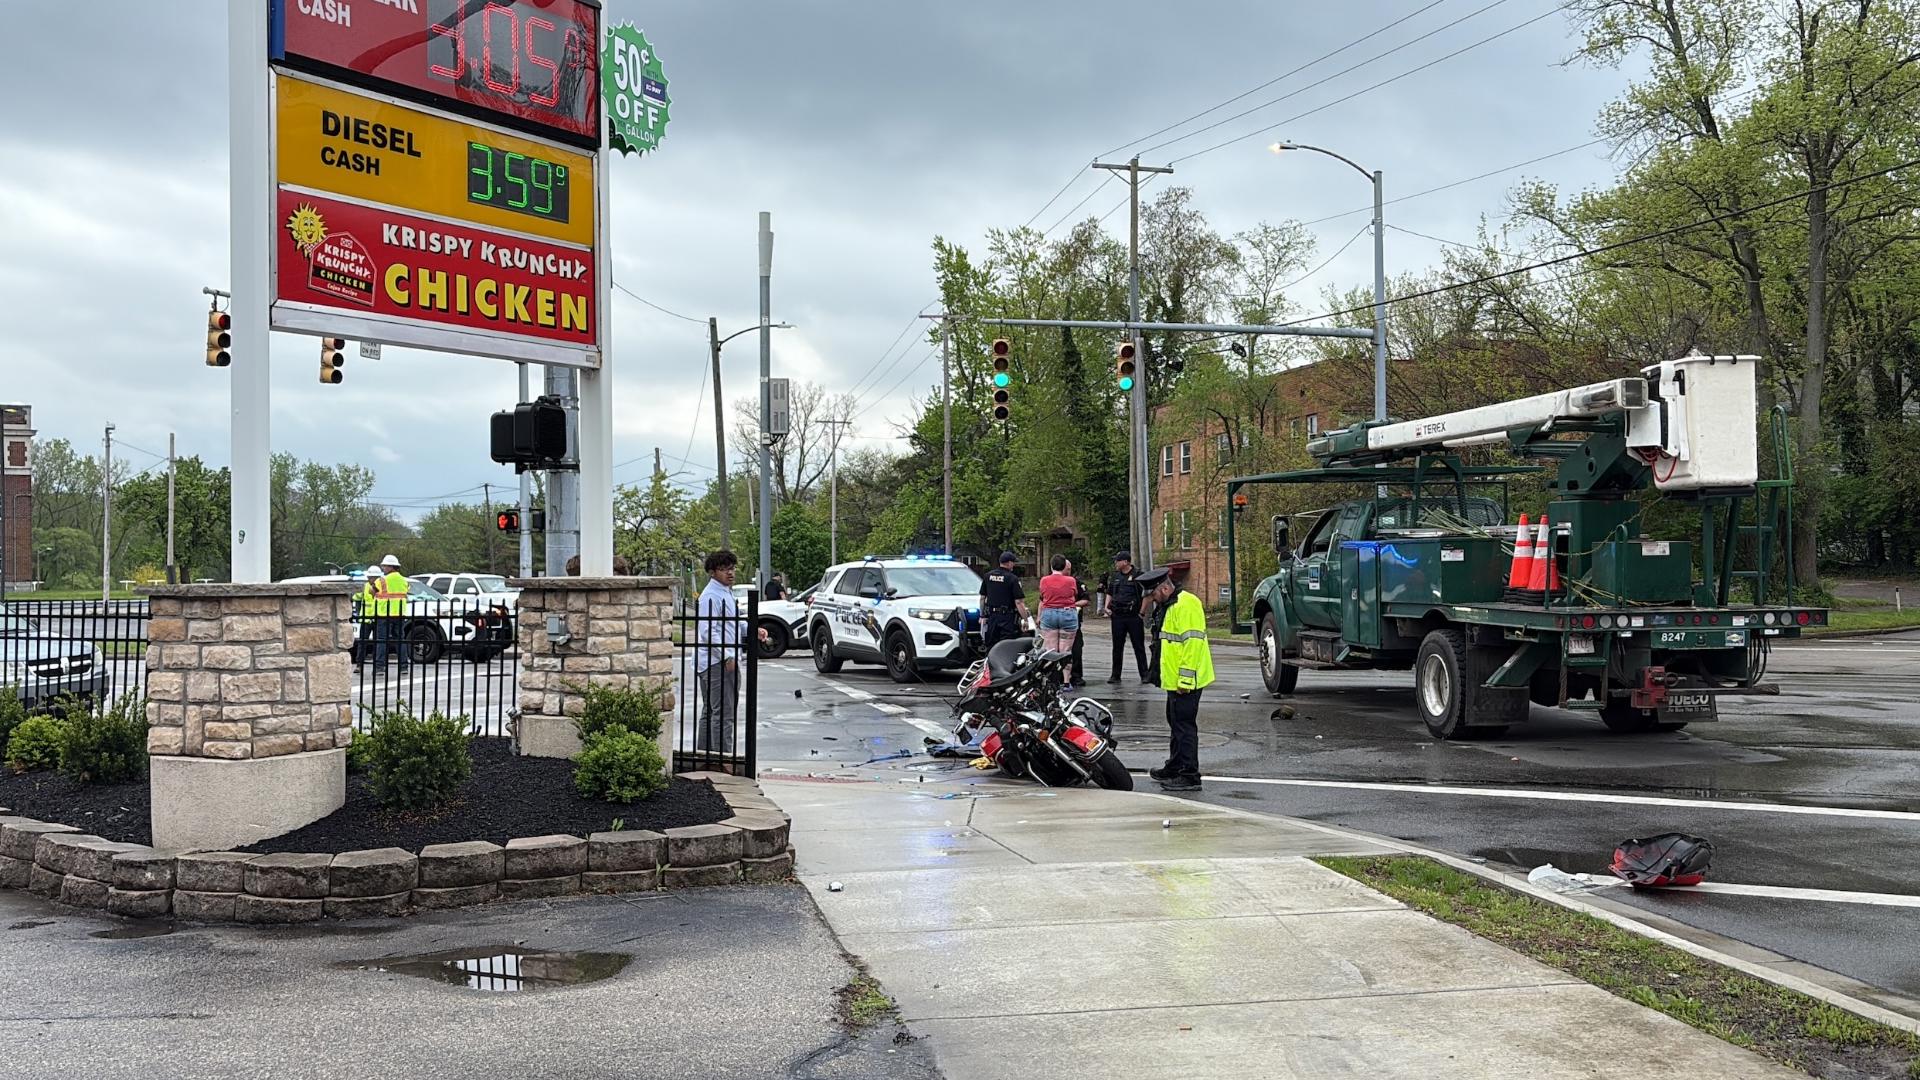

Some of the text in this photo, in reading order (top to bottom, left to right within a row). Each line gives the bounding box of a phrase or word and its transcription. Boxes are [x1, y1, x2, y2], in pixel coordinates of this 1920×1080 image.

[298, 0, 350, 27] CASH
[615, 93, 659, 130] OFF
[322, 110, 421, 158] DIESEL
[625, 123, 655, 144] GALLON
[320, 146, 380, 176] CASH
[324, 243, 366, 265] KRISPY
[382, 223, 587, 280] KRISPY KRUNCHY
[317, 252, 370, 278] KRUNCHY
[320, 269, 366, 290] CHICKEN
[384, 263, 588, 331] CHICKEN
[1423, 421, 1446, 435] TEREX
[1661, 632, 1686, 642] 8247
